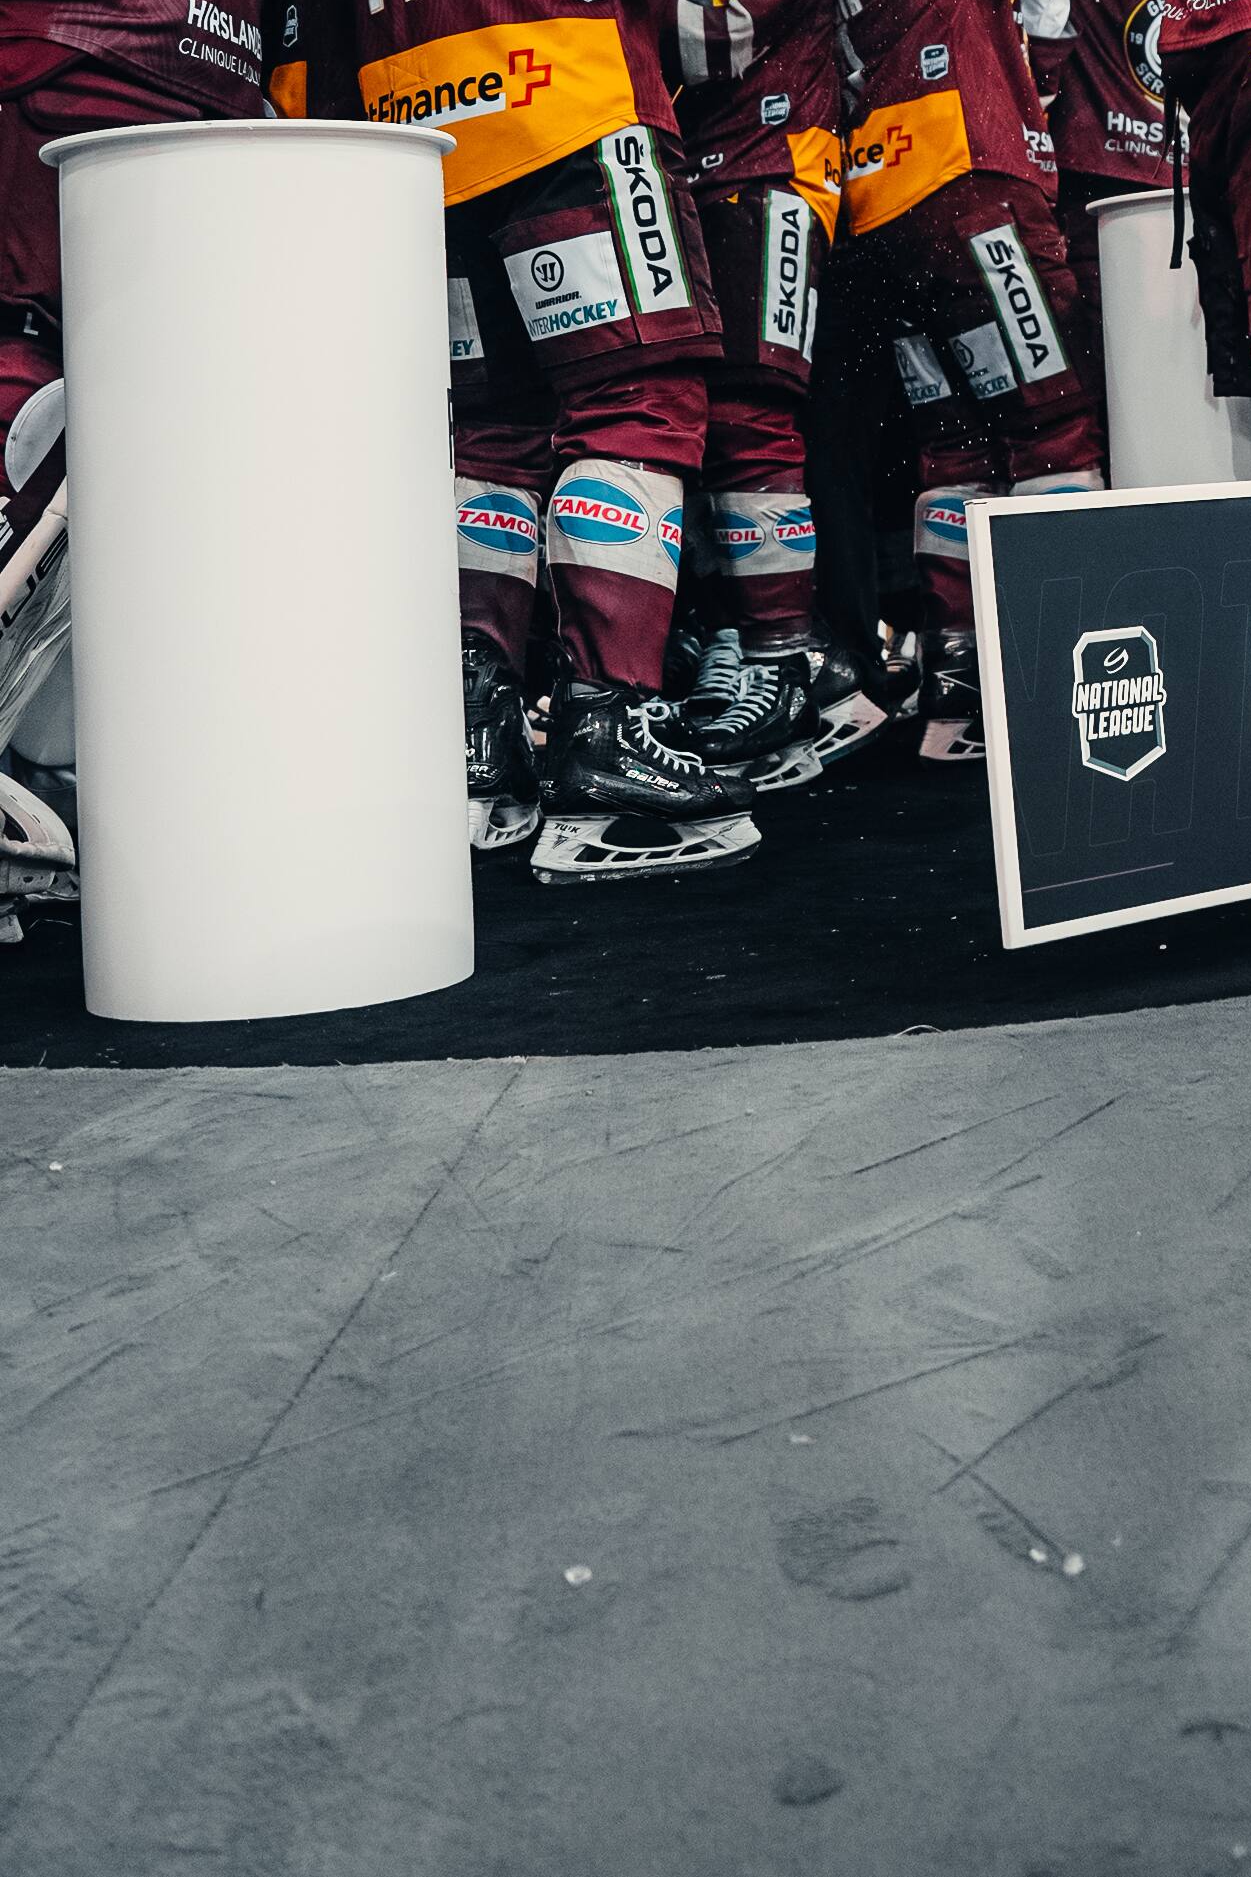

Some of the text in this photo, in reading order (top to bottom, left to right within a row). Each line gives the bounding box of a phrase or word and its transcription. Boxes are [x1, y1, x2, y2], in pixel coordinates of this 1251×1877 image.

[178, 37, 237, 74] CLINIQUE
[614, 135, 673, 298] ŠKODA
[773, 208, 801, 336] ŠKODA
[985, 239, 1050, 369] ŠKODA
[457, 509, 537, 542] TAMOIL
[552, 497, 645, 532] TAMOIL
[1076, 675, 1163, 712] NATIONAL
[1087, 704, 1155, 741] LEAGUE
